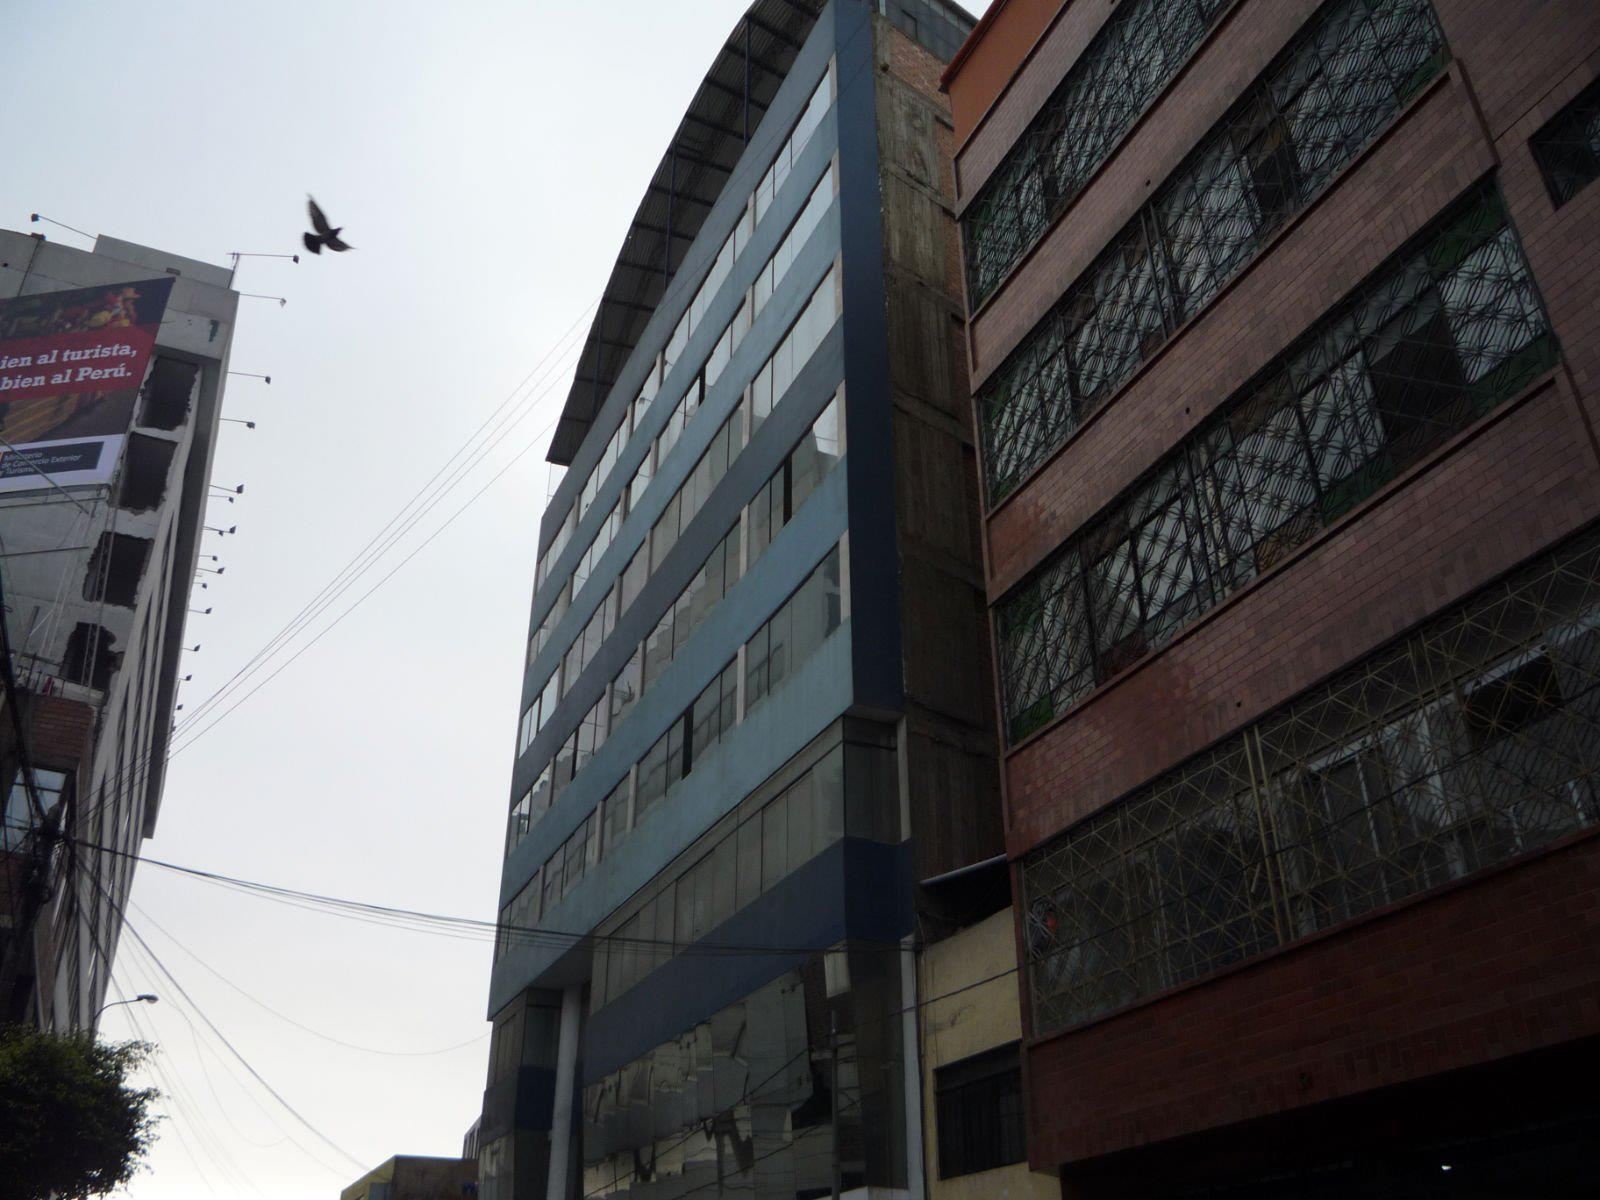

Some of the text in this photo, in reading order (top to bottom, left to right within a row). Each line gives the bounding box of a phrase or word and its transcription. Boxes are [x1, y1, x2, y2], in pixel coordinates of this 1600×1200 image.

[37, 350, 58, 364] al
[62, 344, 137, 362] turista,
[0, 363, 132, 390] bien al Perú.
[51, 455, 82, 463] Exterior
